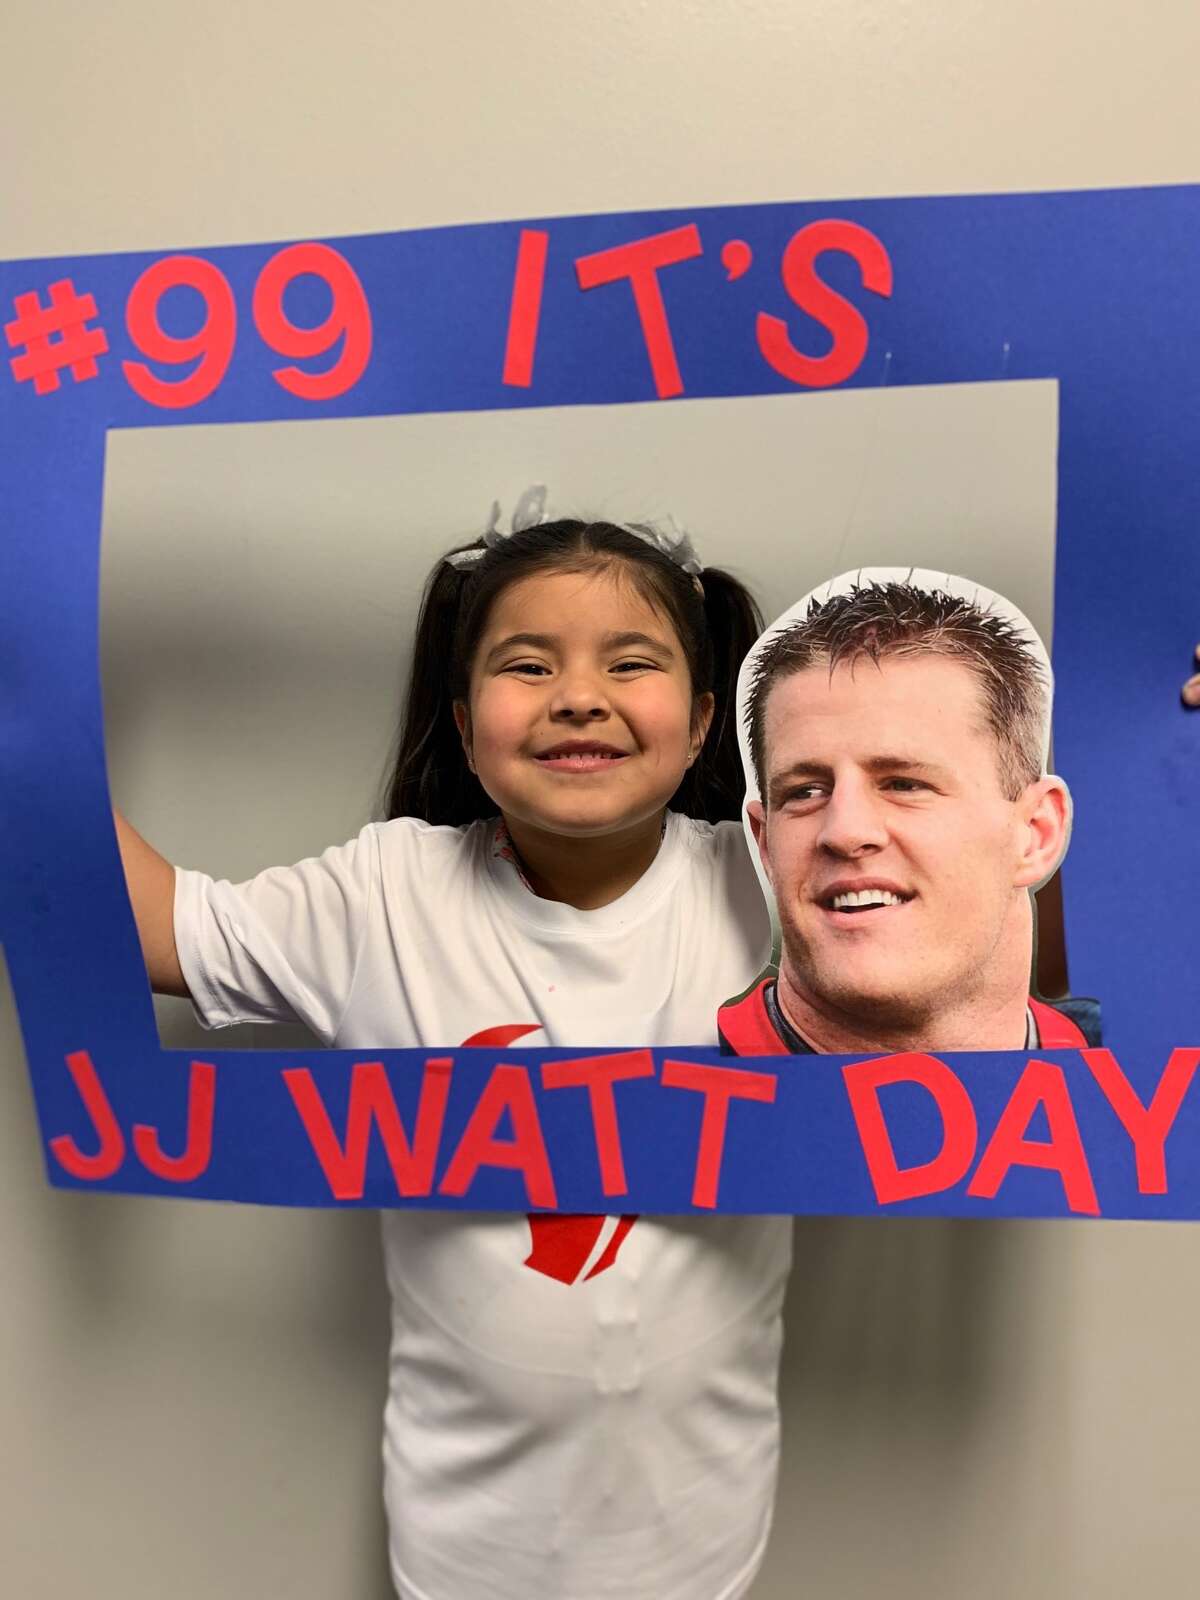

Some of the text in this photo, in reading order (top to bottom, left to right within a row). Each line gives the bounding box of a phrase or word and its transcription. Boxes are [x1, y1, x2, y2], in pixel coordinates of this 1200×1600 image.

[4, 219, 893, 409] #99 IT'S
[50, 1047, 1200, 1217] JJ WATT DAY
